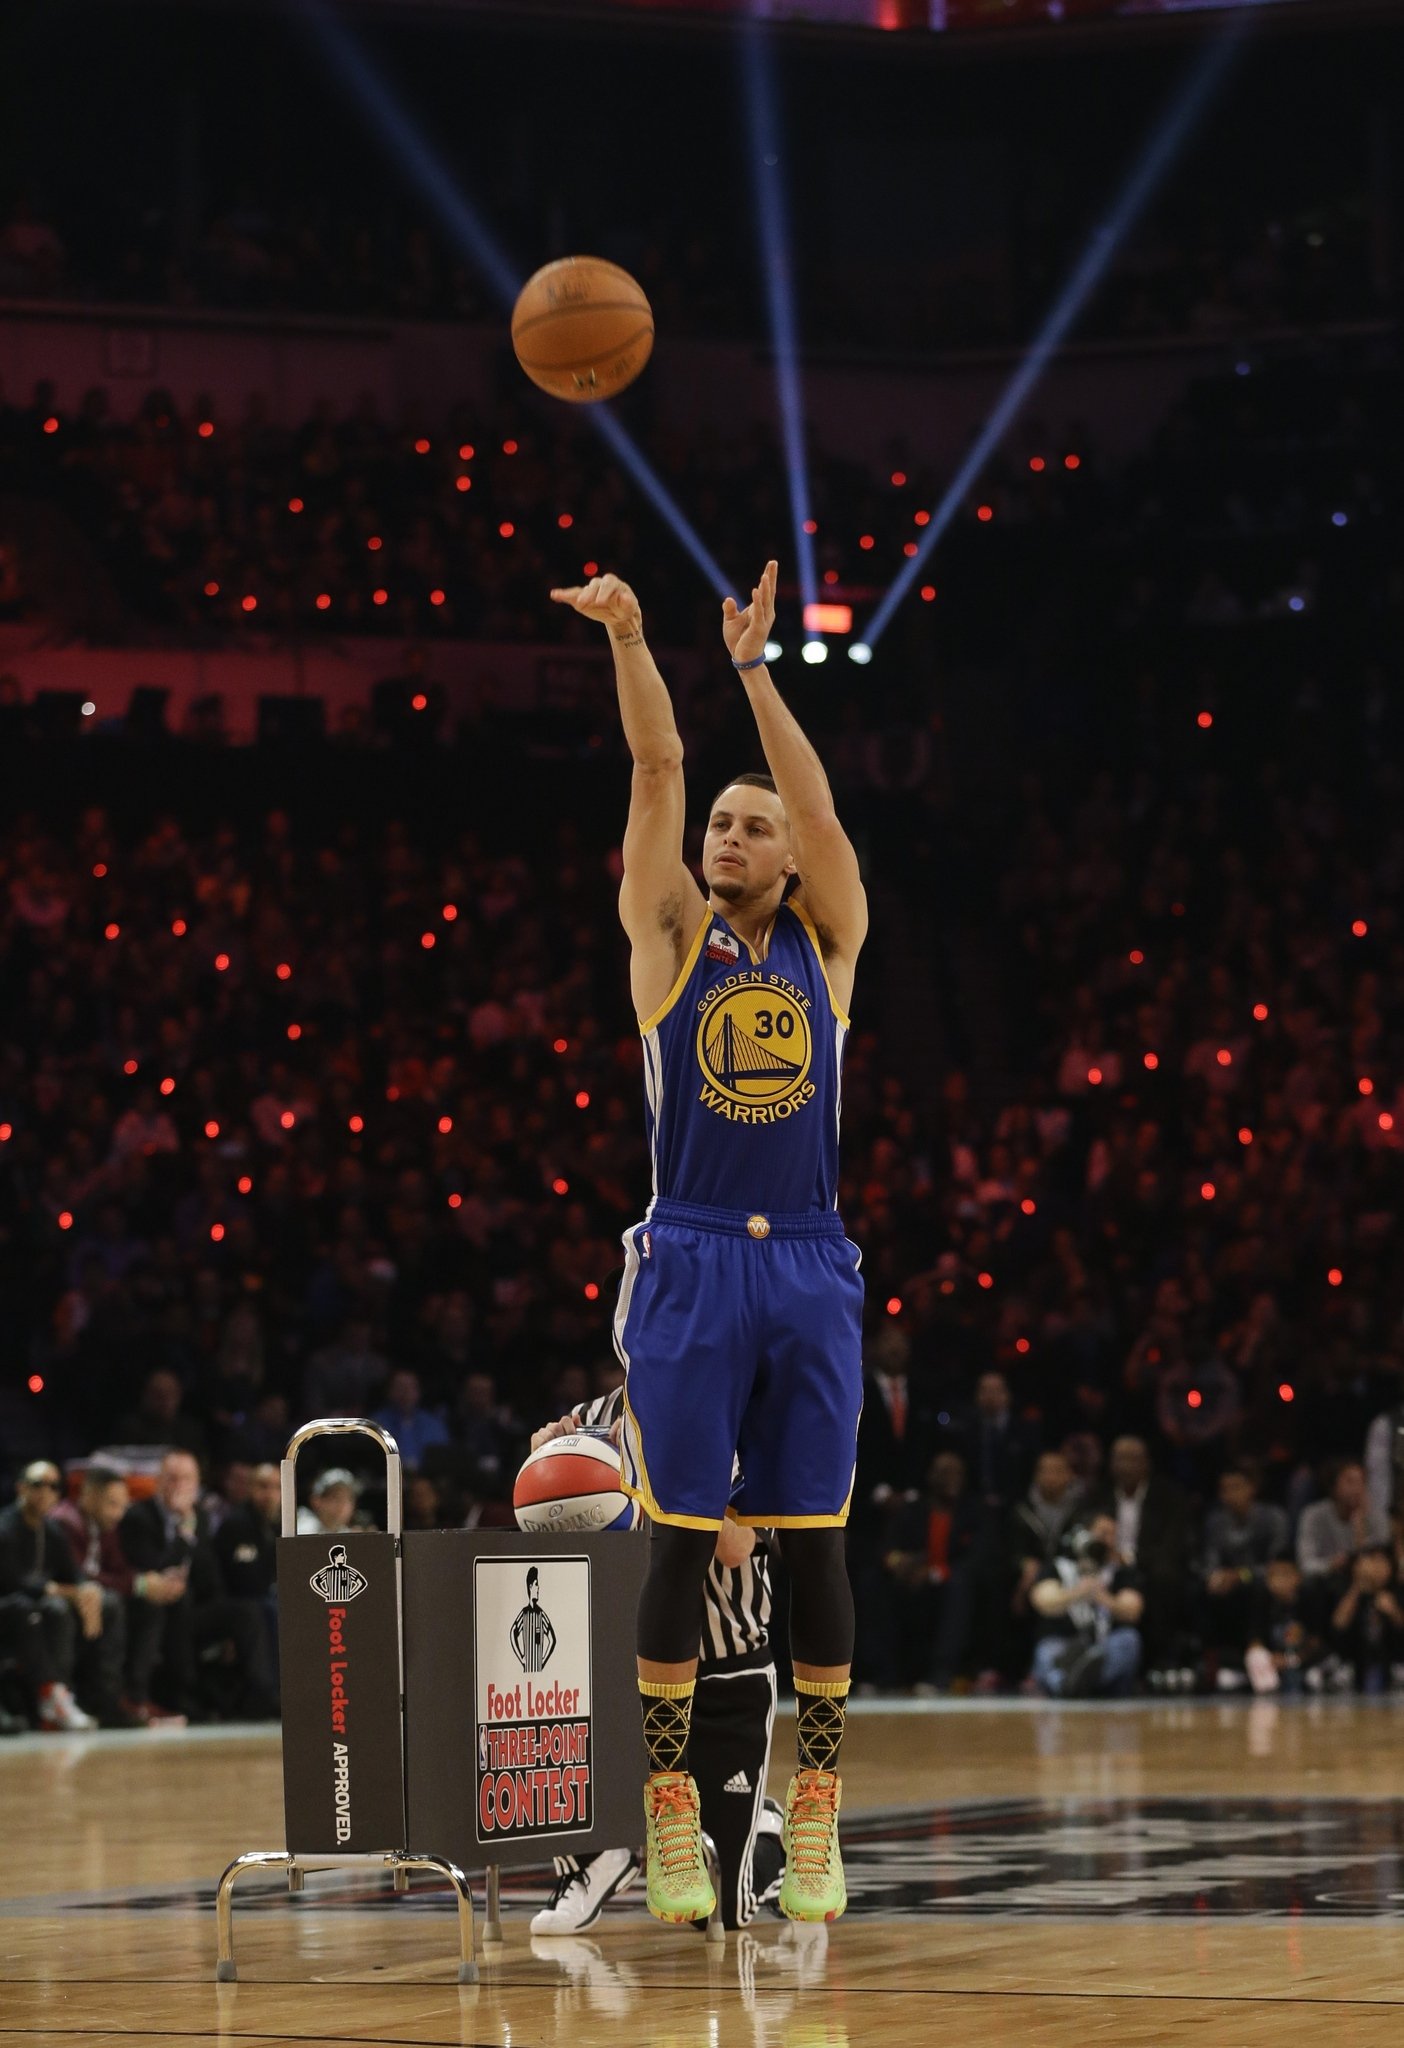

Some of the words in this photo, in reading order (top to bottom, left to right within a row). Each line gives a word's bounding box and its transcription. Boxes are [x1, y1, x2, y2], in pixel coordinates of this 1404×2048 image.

[697, 971, 762, 1012] GOLDEN
[769, 974, 812, 1011] STATE
[754, 1010, 795, 1039] 30
[698, 1079, 816, 1124] WARRIORS
[750, 1221, 766, 1233] W
[328, 1607, 346, 1655] Foot
[330, 1661, 349, 1734] Locker
[487, 1683, 522, 1720] Foot
[527, 1680, 580, 1718] Locker
[488, 1723, 589, 1770] THREE-POINT
[480, 1765, 590, 1832] CONTEST
